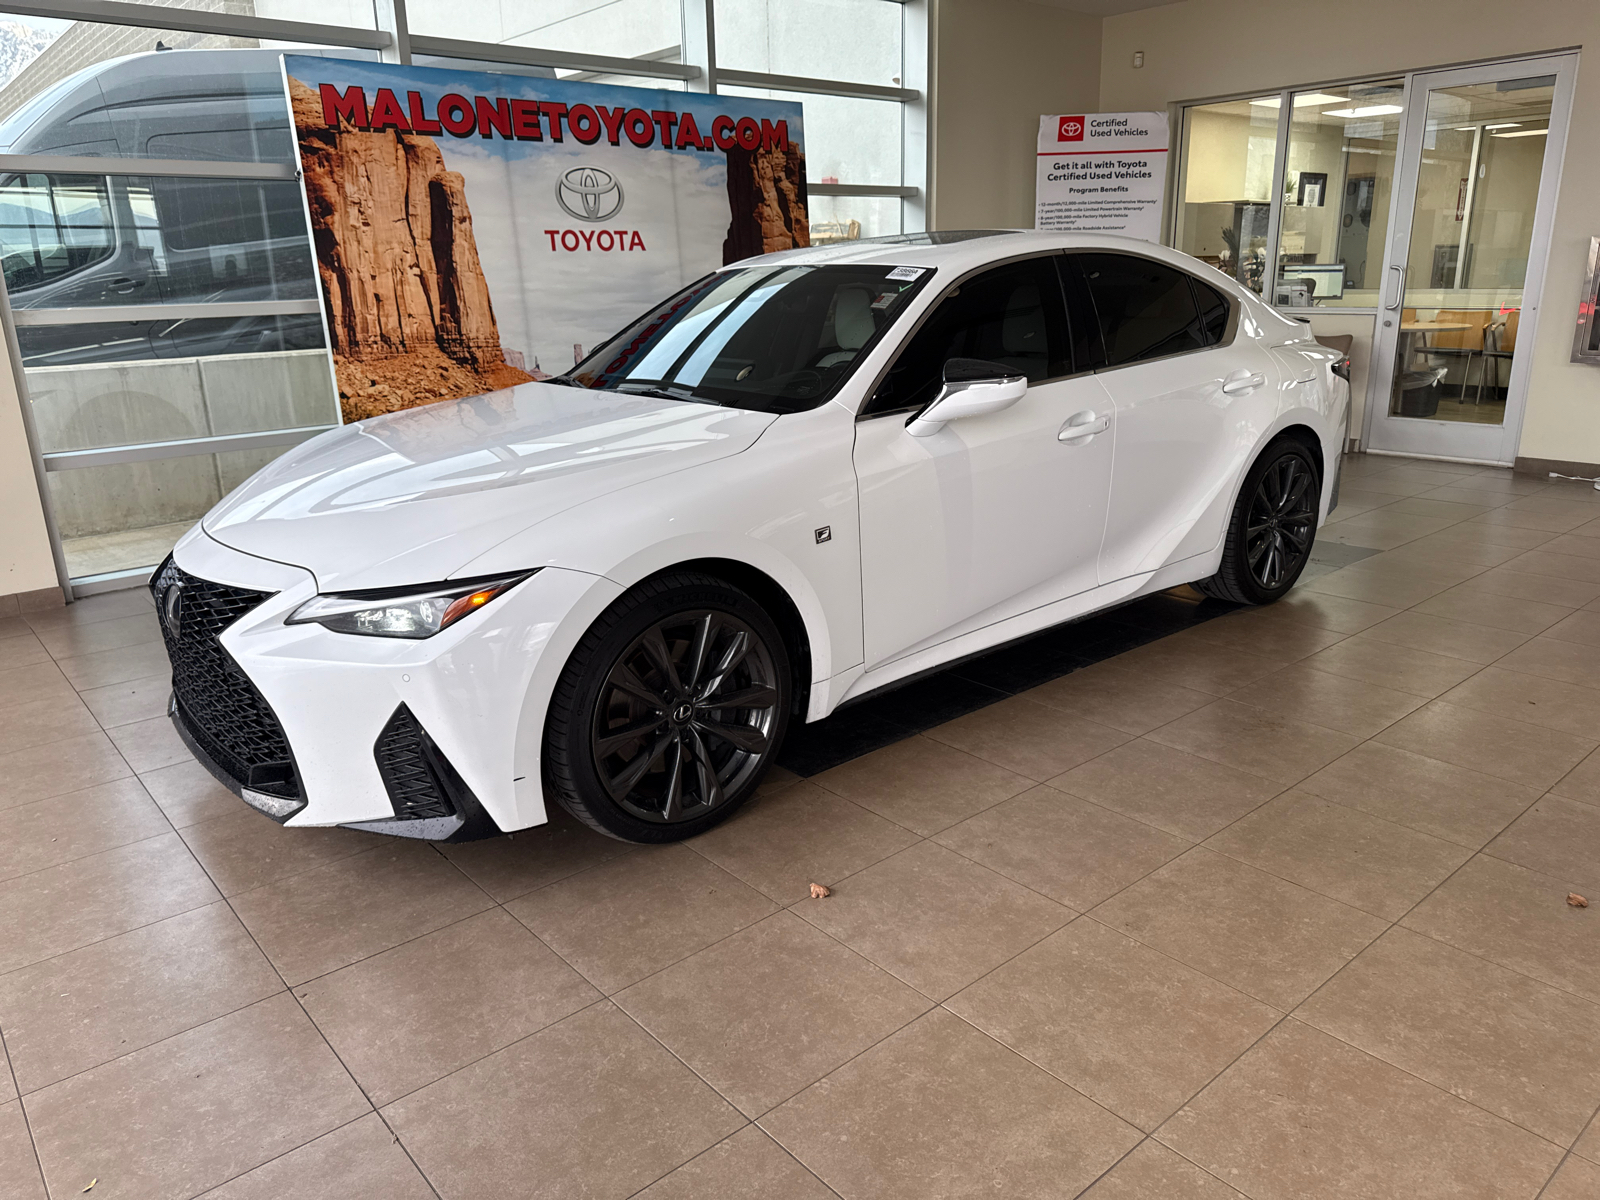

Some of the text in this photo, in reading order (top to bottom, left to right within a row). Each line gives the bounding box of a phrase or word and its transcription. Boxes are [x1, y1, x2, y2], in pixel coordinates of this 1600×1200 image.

[318, 83, 788, 154] MALONETOYOTA.COM
[1090, 118, 1128, 127] Certified
[1090, 128, 1149, 137] Used Vehicles
[1053, 160, 1147, 170] Get it all with Toyota
[1047, 170, 1152, 181] Certified Used Vehicles
[1069, 187, 1099, 195] Program
[543, 229, 647, 252] TOYOTA
